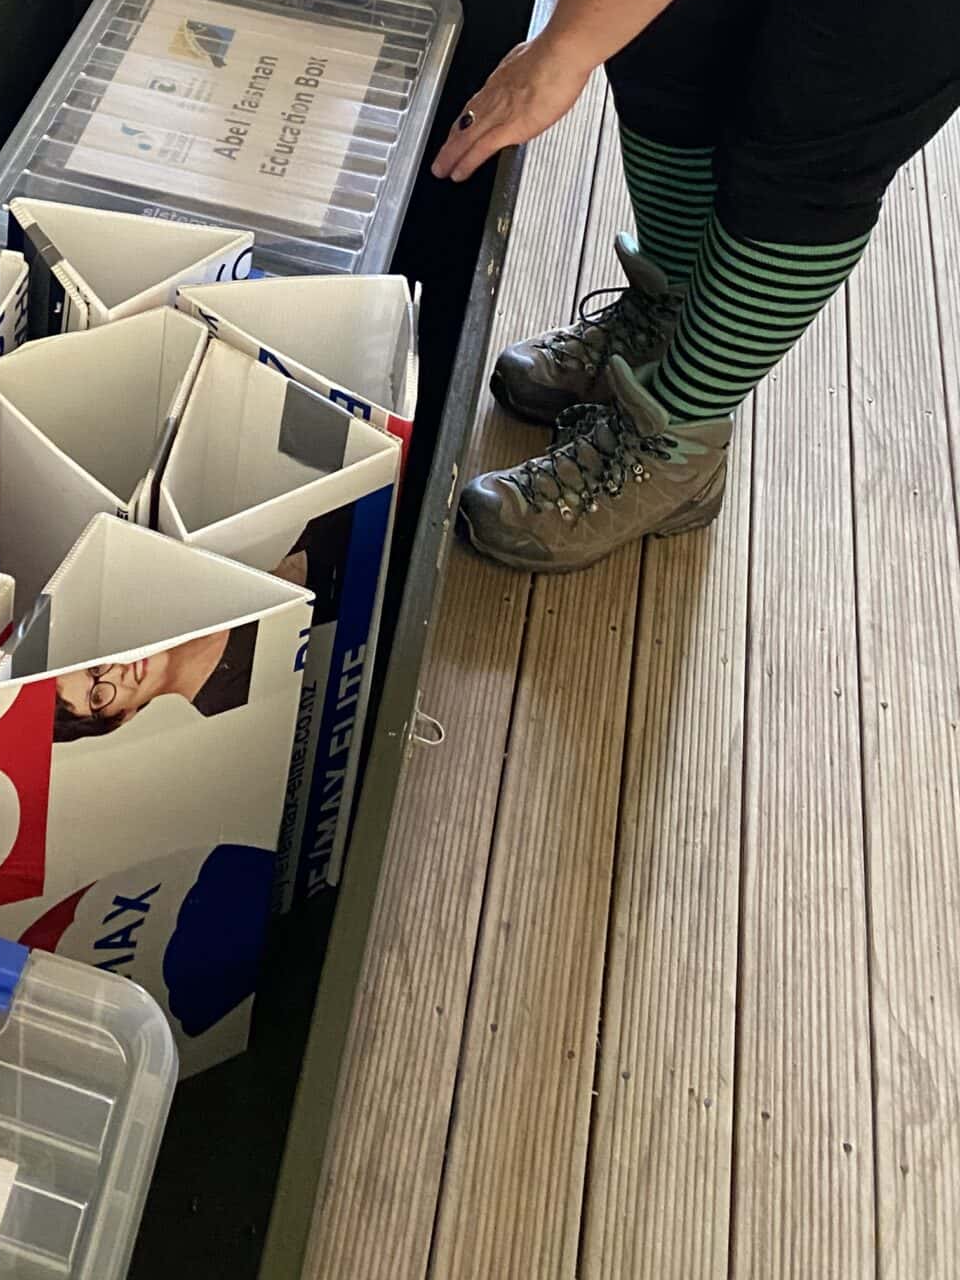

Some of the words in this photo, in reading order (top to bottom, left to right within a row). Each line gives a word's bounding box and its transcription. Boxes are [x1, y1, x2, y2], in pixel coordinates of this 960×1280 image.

[213, 118, 251, 161] Abel
[233, 55, 278, 114] Tasman
[259, 92, 315, 177] Education
[295, 56, 329, 89] Box
